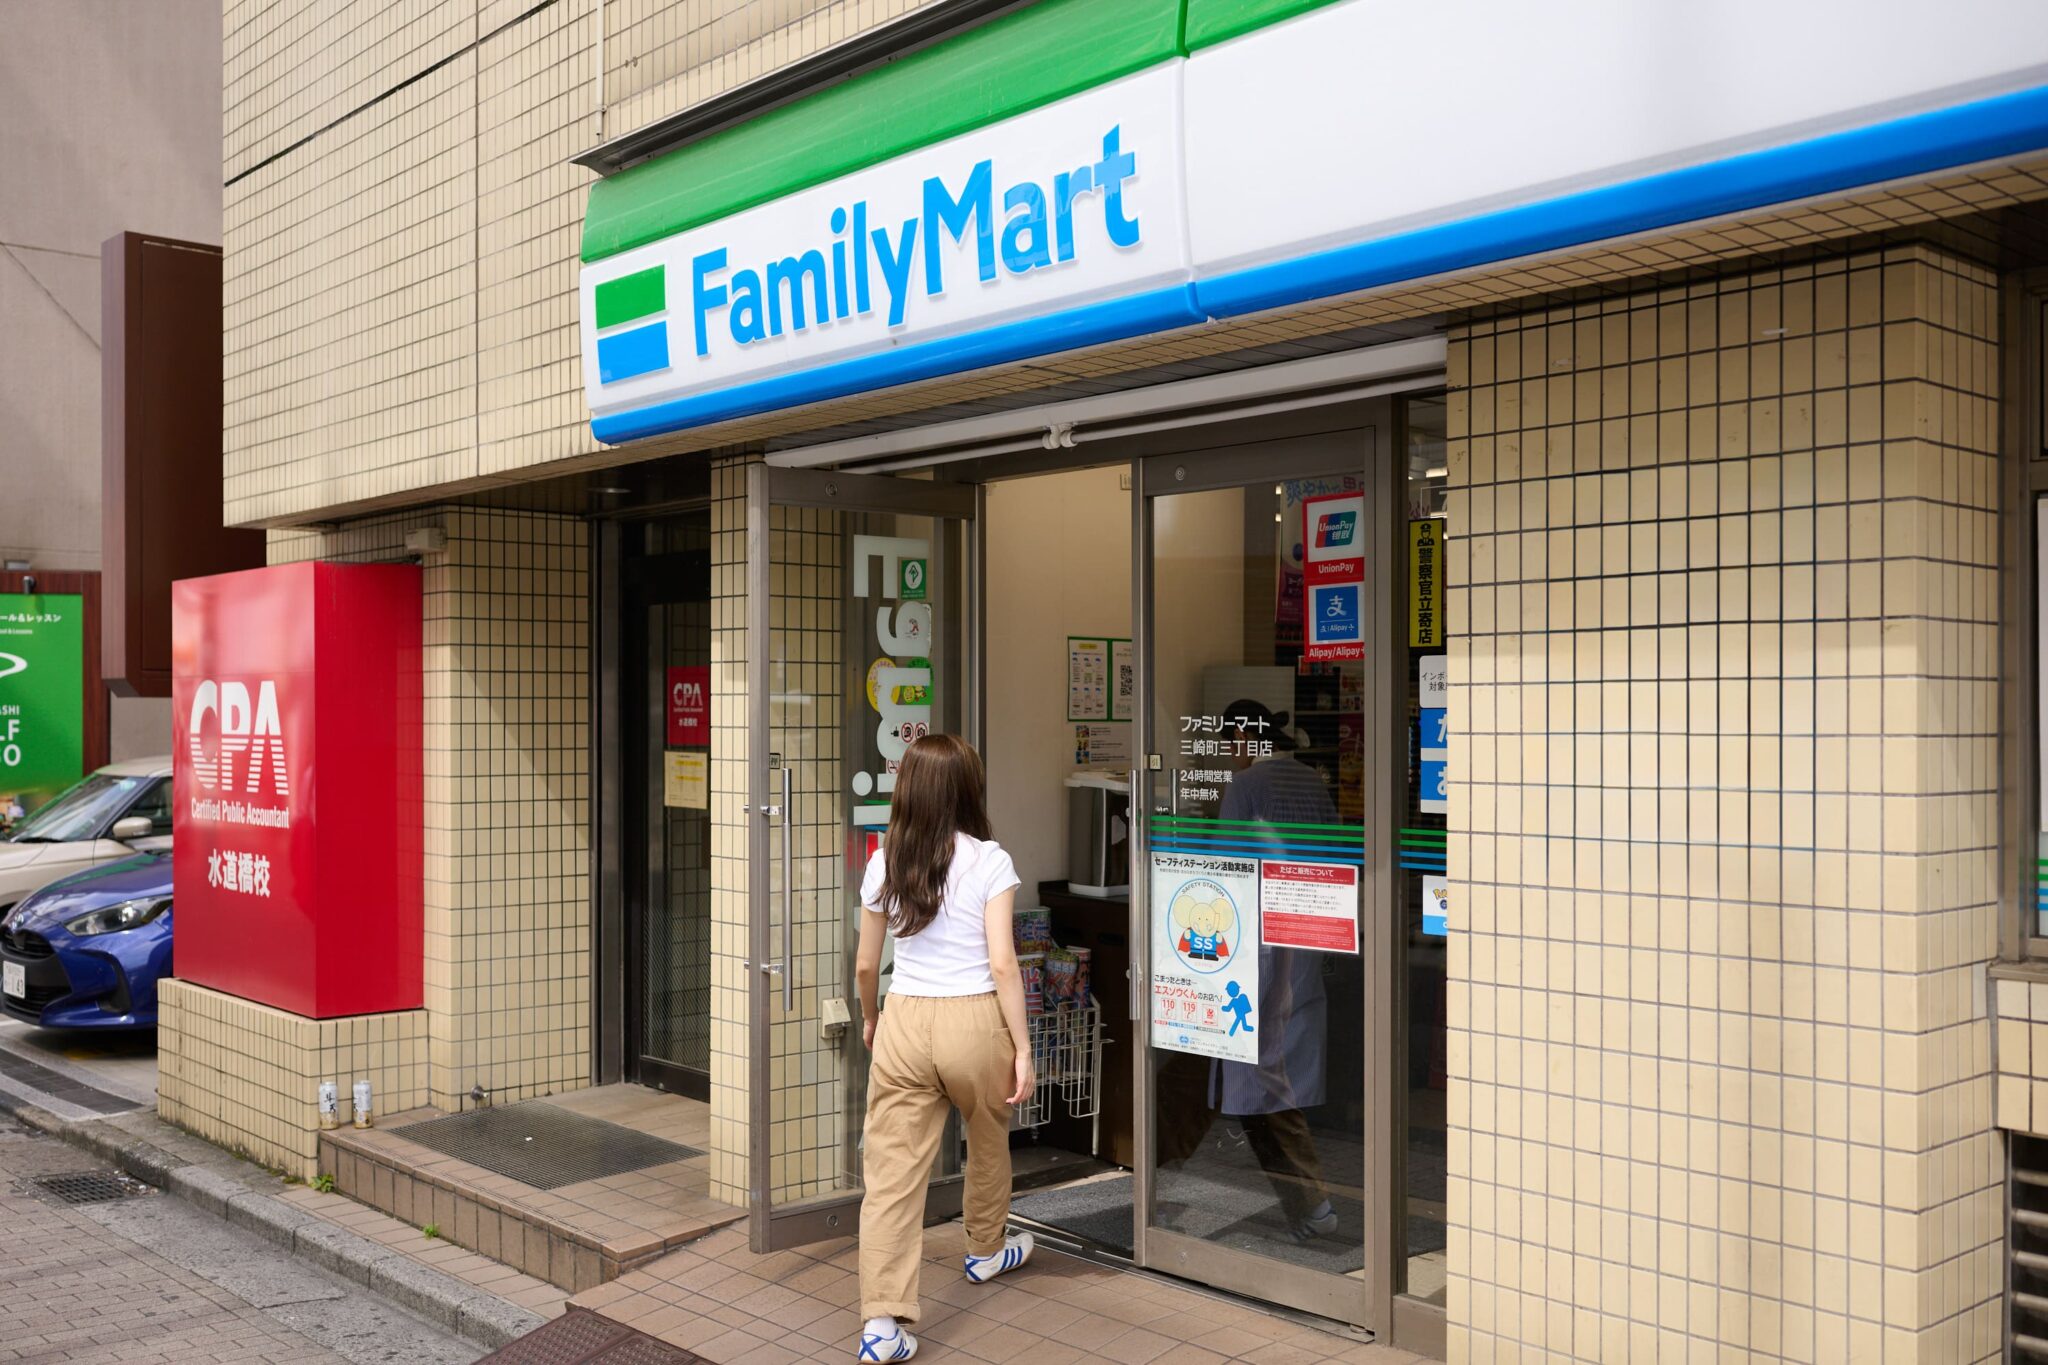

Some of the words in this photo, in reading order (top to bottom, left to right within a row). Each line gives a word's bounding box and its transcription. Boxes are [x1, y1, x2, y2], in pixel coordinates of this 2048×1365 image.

[692, 123, 1140, 357] FamilyMart
[1319, 520, 1353, 533] UnionPay
[1318, 562, 1354, 574] UnionPay
[1418, 548, 1433, 644] 警察官立寄店
[673, 682, 703, 706] CPA
[1180, 715, 1271, 734] ファミリーマート
[190, 680, 289, 796] CPA
[1180, 739, 1273, 757] 三崎町三丁目店
[1180, 769, 1232, 783] 24時間営業
[1180, 787, 1219, 801] 年中無休
[191, 797, 220, 821] Certified
[222, 800, 245, 824] Public
[246, 802, 289, 829] Accountant
[208, 848, 270, 898] 水道橋校
[1155, 856, 1255, 873] セーフティステーション活動実施店
[1280, 866, 1334, 877] たばこ販売について
[1181, 882, 1201, 894] SAFETY
[1202, 882, 1225, 897] STATION
[1193, 936, 1213, 950] SS
[1162, 999, 1175, 1010] 110
[1183, 1002, 1196, 1012] 119
